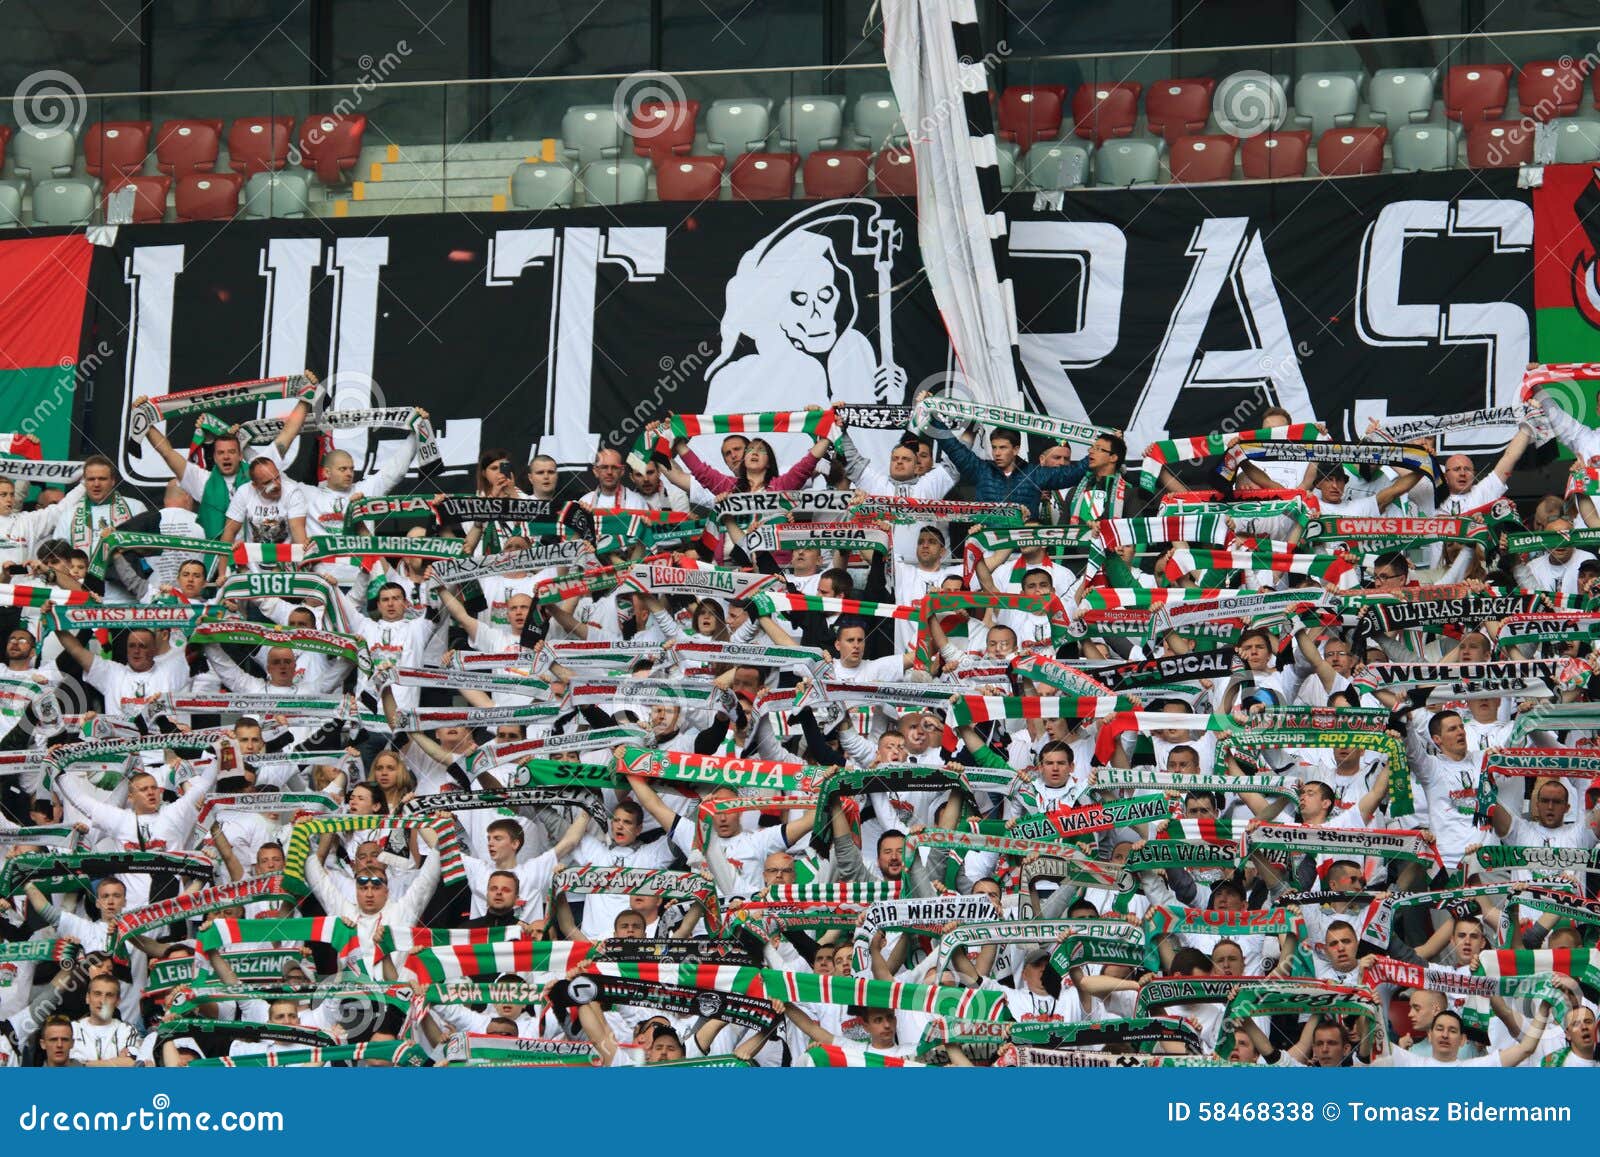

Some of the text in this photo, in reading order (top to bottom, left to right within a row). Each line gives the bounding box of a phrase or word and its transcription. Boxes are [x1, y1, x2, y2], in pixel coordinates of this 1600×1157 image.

[419, 442, 438, 460] 1916
[351, 498, 431, 519] EGIA
[445, 498, 551, 516] ULTRAS LEGIA
[802, 493, 852, 510] POLS
[809, 530, 866, 540] LEGIA
[1340, 520, 1397, 534] CWKS
[1401, 520, 1458, 534] LEGIA
[326, 537, 464, 555] LEGIA WARSZAWA
[795, 540, 876, 549] WARSZAWA
[1017, 539, 1079, 547] WARSZAWA
[1513, 536, 1544, 546] LEGIA
[71, 607, 189, 622] CWKS LEGIA
[1387, 600, 1467, 624] ULTRAS
[1469, 596, 1525, 618] LEGIA
[1096, 619, 1233, 638] KAZI EYNA
[676, 754, 784, 788] LEGIA
[1011, 799, 1167, 840] EGIA WARSZAWA
[1262, 827, 1404, 848] Legia Warszawa
[1129, 845, 1172, 864] EGIA
[908, 902, 1000, 920] WARSZAWA
[1183, 907, 1286, 927] FORZA
[997, 924, 1143, 945] WARSZAWA
[156, 965, 194, 984] LEGI
[1366, 962, 1420, 987] UCHAR
[436, 983, 546, 1002] LEGIA WARSZ
